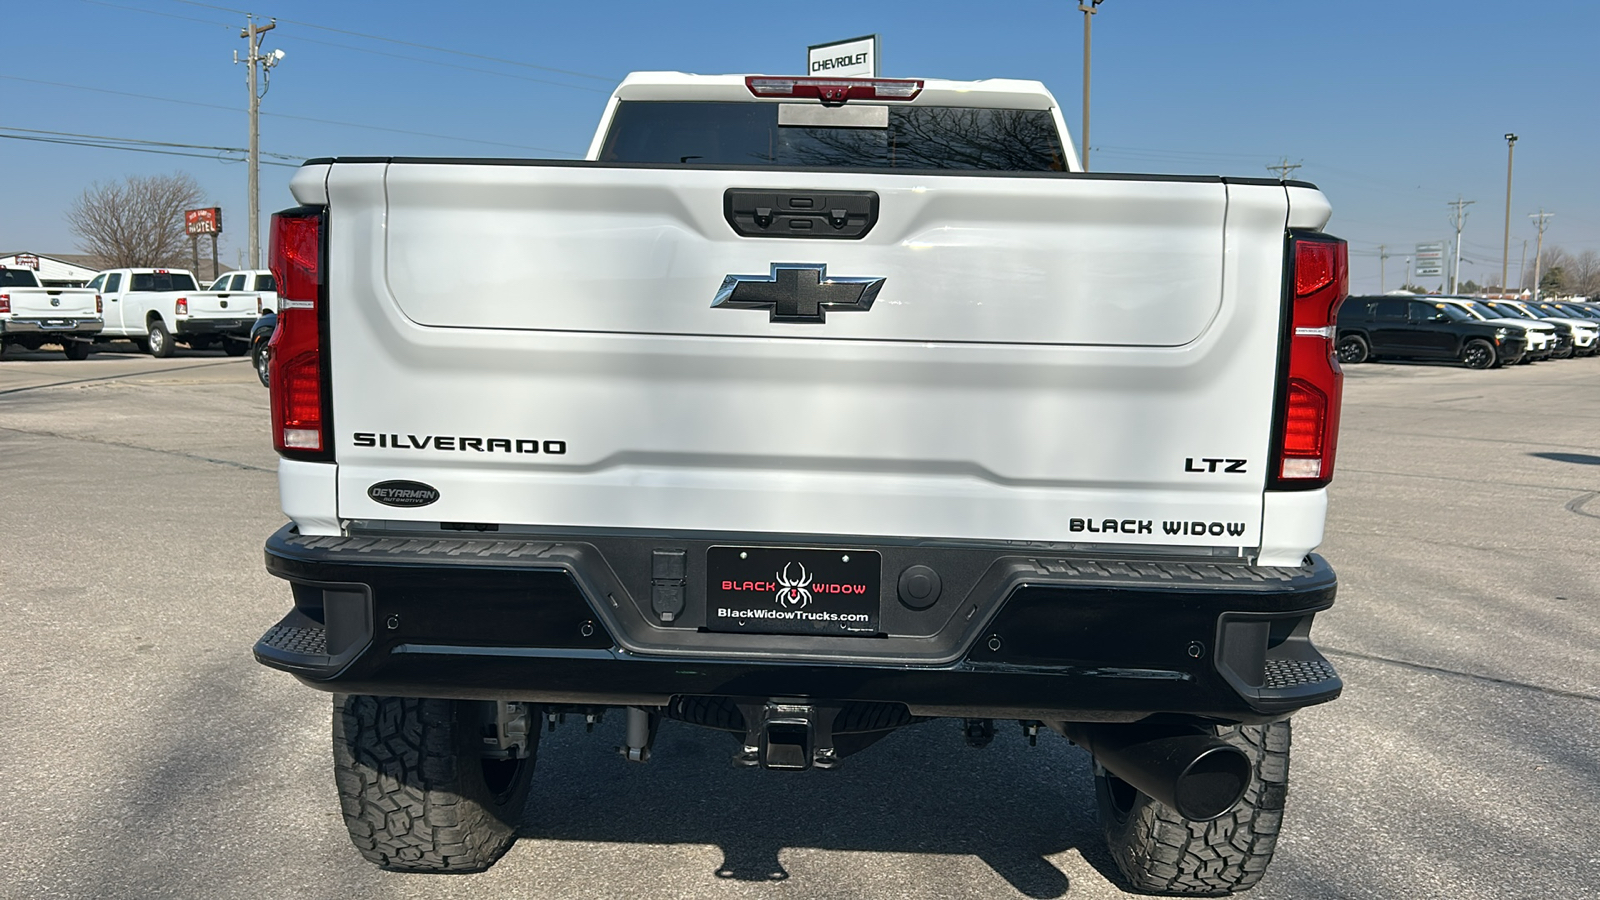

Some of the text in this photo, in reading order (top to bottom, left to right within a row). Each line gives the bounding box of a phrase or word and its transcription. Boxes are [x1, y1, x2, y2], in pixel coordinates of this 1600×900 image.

[812, 52, 868, 72] CHEVROLET
[188, 220, 216, 233] MOTEL
[353, 432, 567, 455] SILVERADO
[1184, 457, 1248, 473] LTZ
[372, 487, 435, 499] DEYARMAN
[1069, 517, 1246, 537] BLACK WIDOW
[721, 580, 866, 594] BLACK WIDOW
[717, 608, 869, 622] BlackWidowTrucks.com
